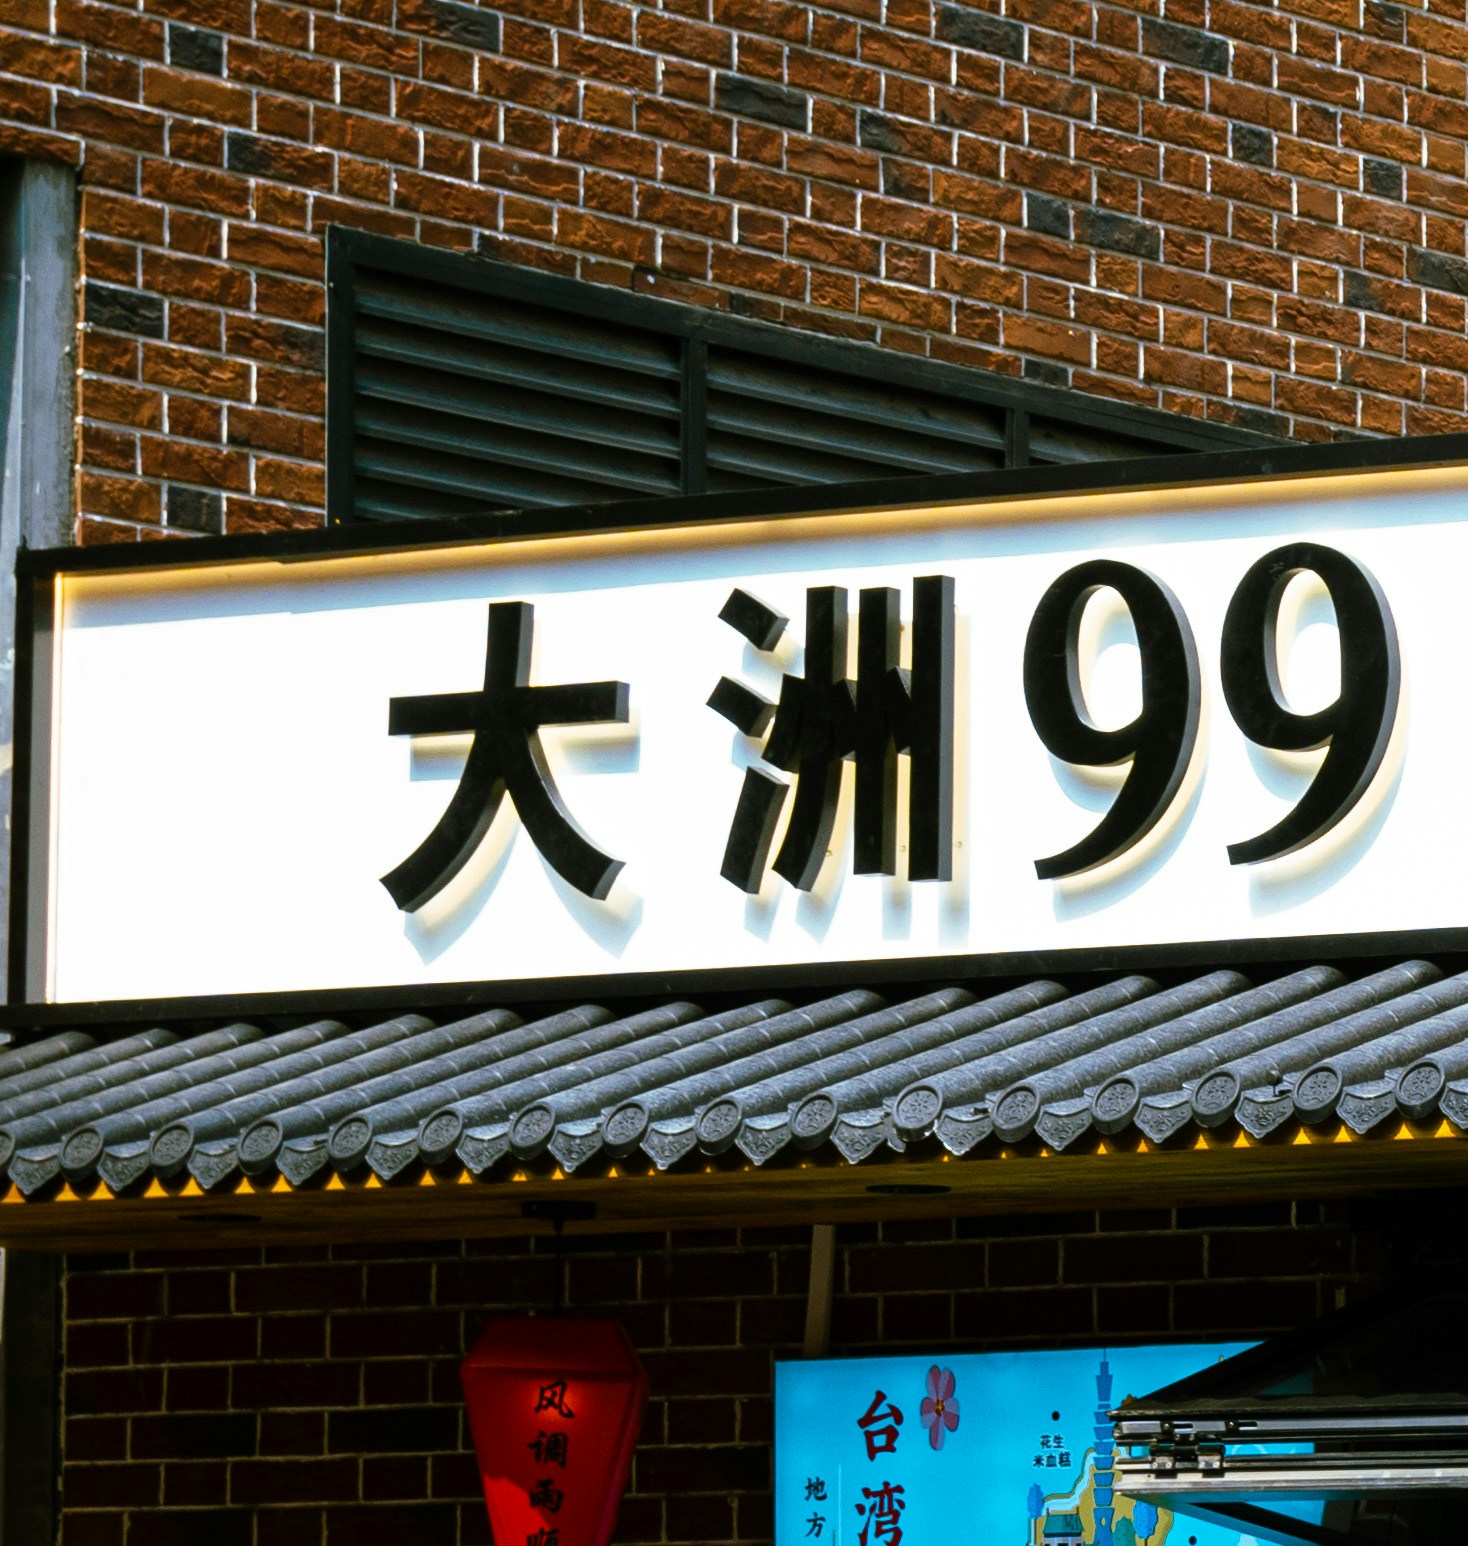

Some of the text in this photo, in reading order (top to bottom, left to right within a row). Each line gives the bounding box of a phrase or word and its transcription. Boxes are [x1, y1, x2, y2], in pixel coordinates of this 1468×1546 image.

[380, 541, 1400, 913] 大洲99
[1040, 1435, 1064, 1449] 花生
[1033, 1452, 1071, 1467] 米血糕
